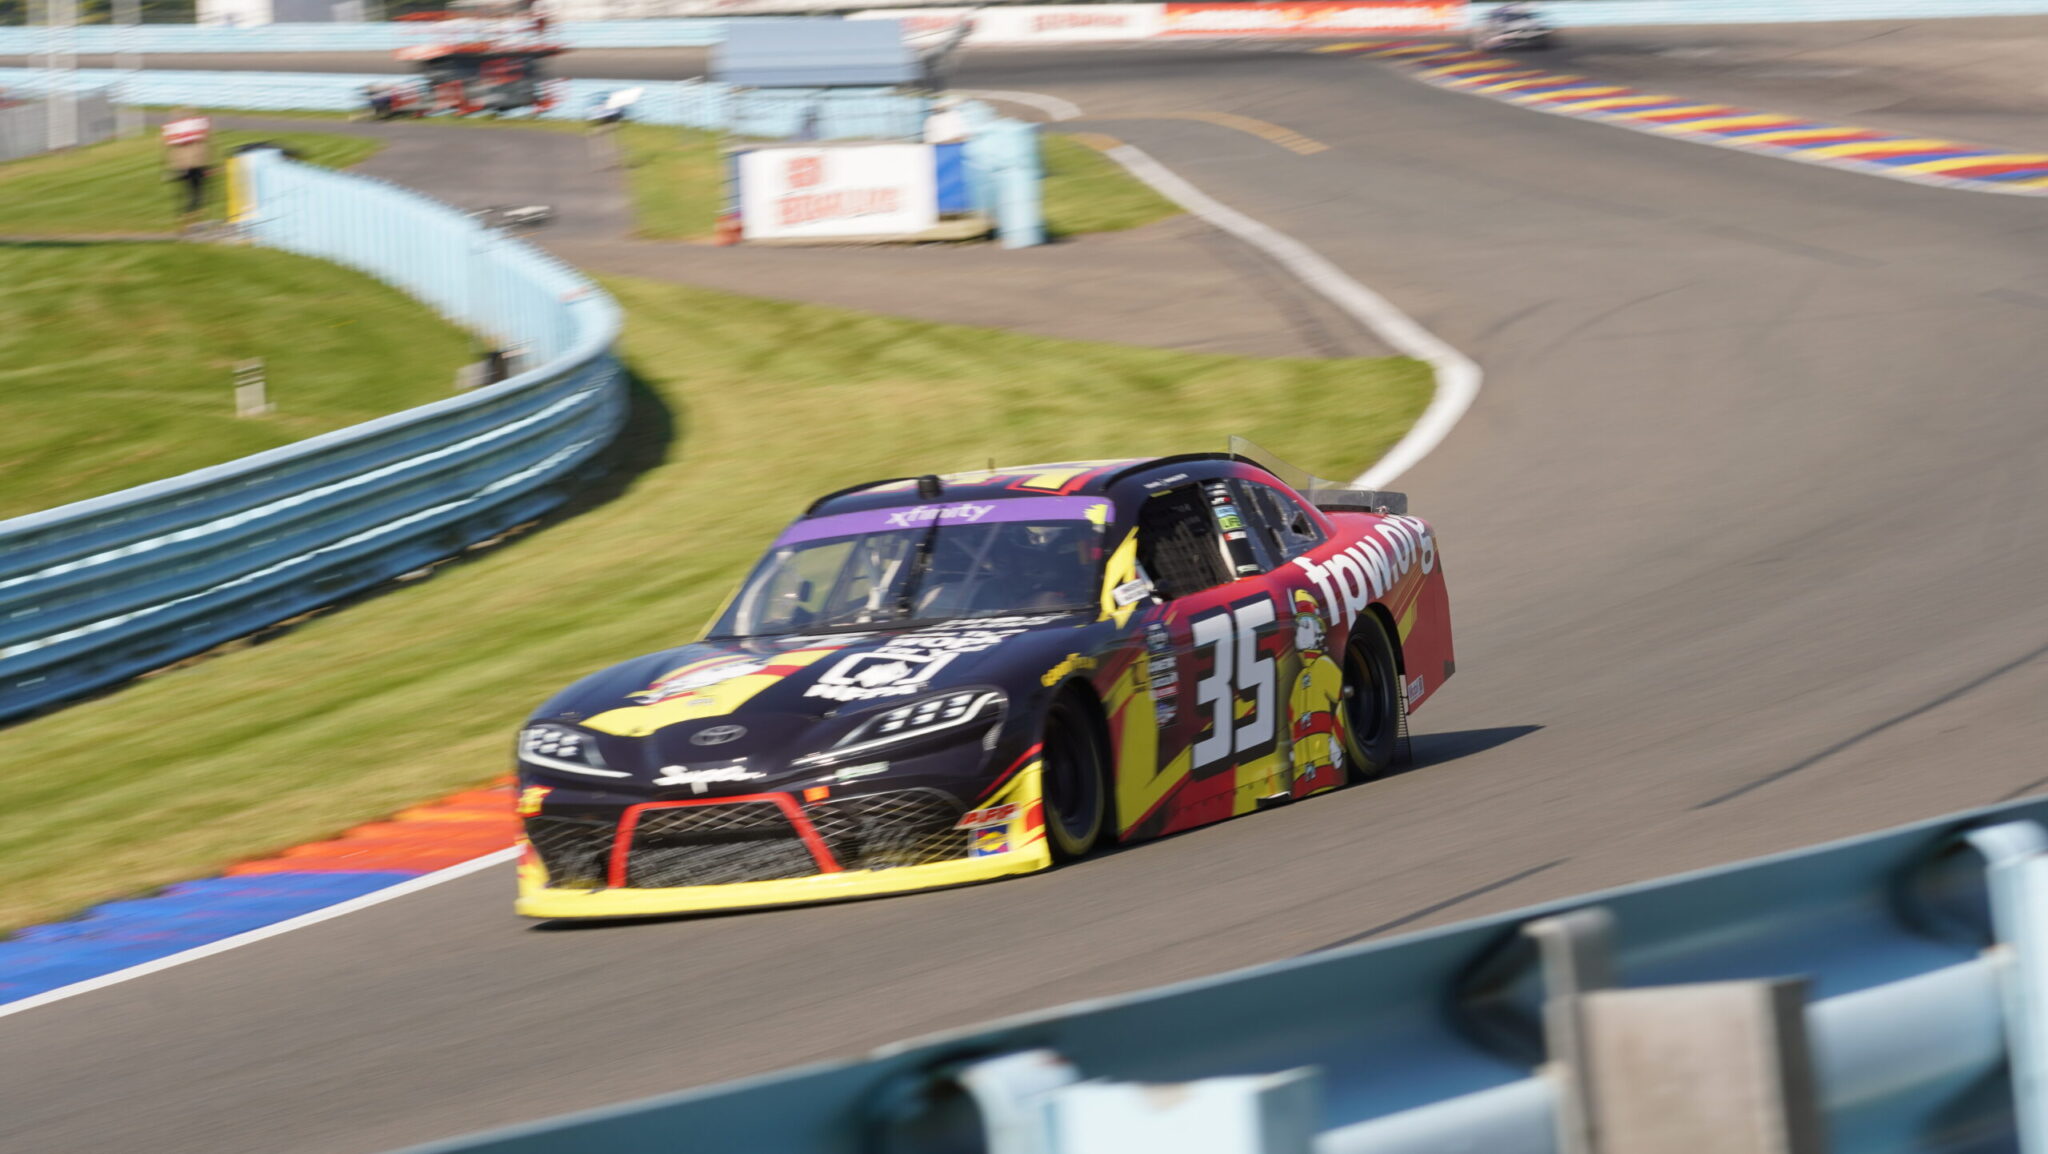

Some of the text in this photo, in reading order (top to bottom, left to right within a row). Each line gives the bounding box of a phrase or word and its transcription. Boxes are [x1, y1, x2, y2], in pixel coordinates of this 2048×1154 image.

[884, 504, 997, 527] xfinity
[1291, 514, 1434, 631] fpw.org
[1192, 598, 1276, 769] 35
